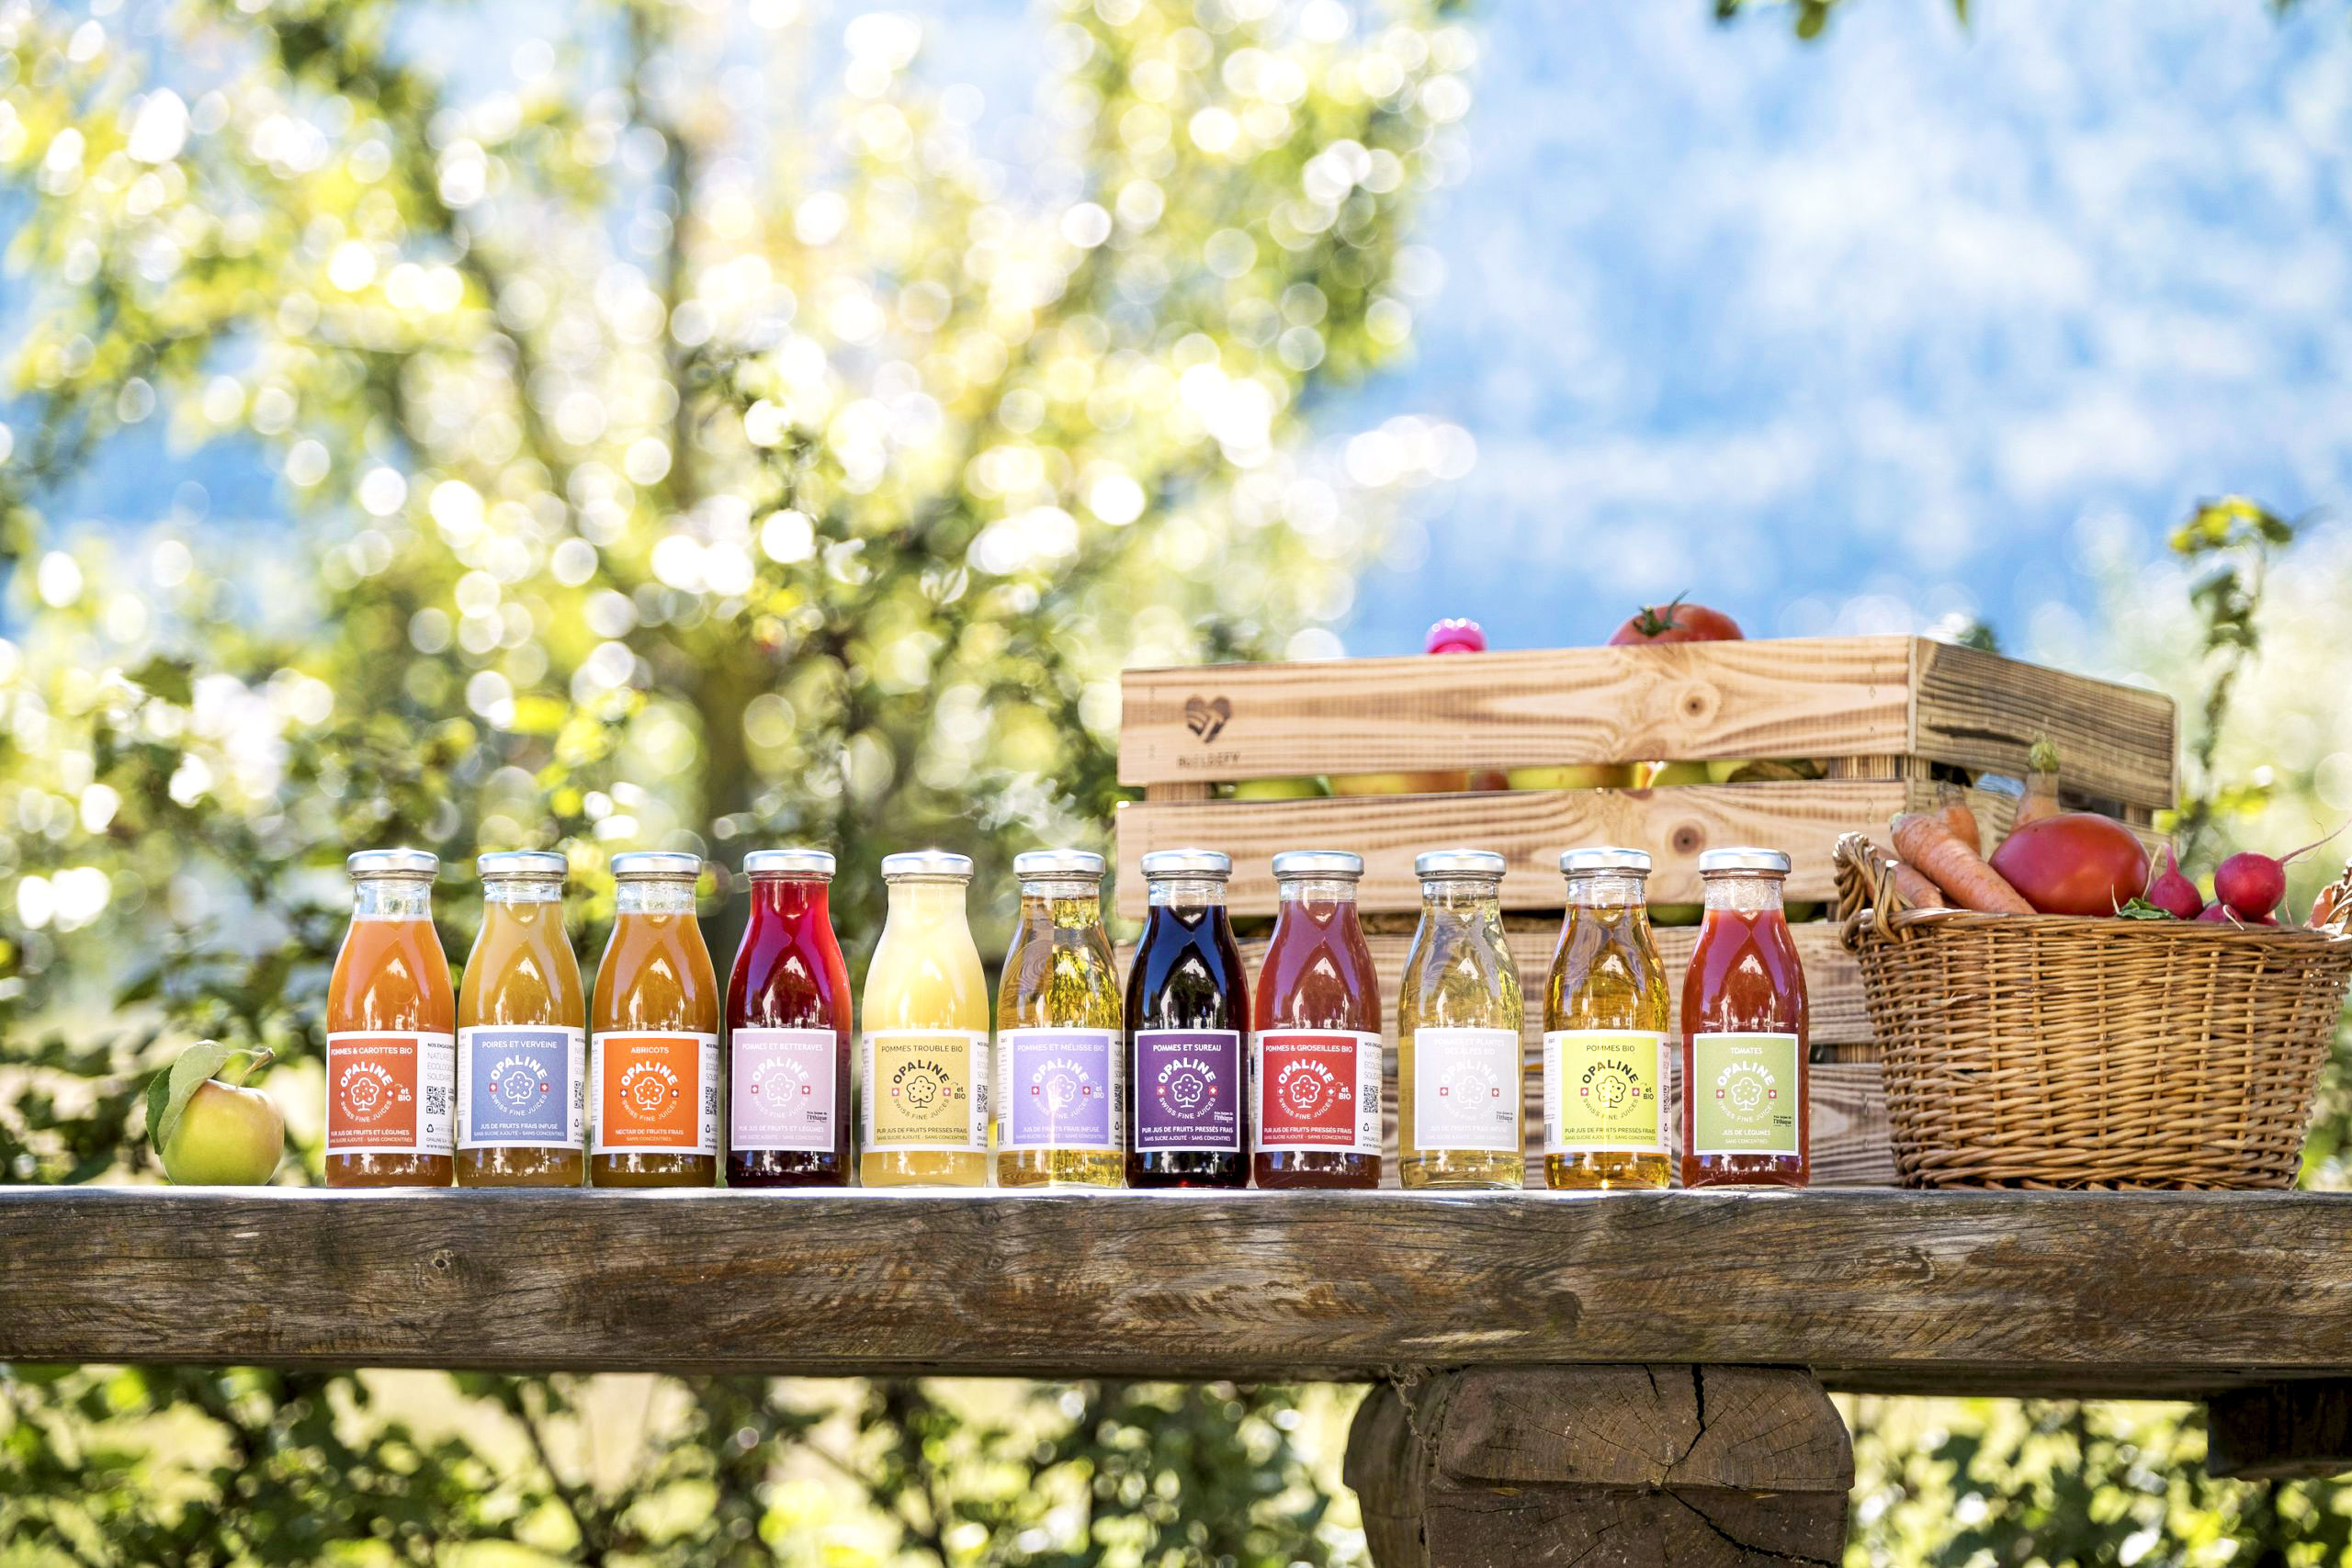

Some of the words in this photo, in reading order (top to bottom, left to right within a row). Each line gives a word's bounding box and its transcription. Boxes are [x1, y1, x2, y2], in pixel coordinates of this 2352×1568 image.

[341, 1062, 393, 1088] OPALINE
[491, 1055, 548, 1080] OPALINE
[621, 1061, 678, 1086] OPALINE
[752, 1056, 808, 1082] OPALINE
[893, 1060, 950, 1084] OPALINE
[1033, 1058, 1089, 1082] OPALINE
[1159, 1057, 1216, 1083] OPALINE
[1279, 1059, 1334, 1084] OPALINE
[1441, 1059, 1498, 1084] OPALINE
[1582, 1060, 1638, 1084] OPALINE
[1717, 1060, 1775, 1086] OPALINE
[341, 1100, 354, 1119] SWISS
[373, 1100, 391, 1120] JUICES
[492, 1094, 507, 1112] SWISS
[528, 1094, 548, 1114] JUICES
[623, 1100, 638, 1118] SWISS
[659, 1100, 676, 1120] JUICES
[893, 1099, 910, 1117] SWISS
[931, 1099, 949, 1118] JUICES
[1159, 1098, 1176, 1116] SWISS
[1197, 1098, 1216, 1117] JUICES
[1279, 1099, 1294, 1116] SWISS
[1314, 1099, 1333, 1117] JUICES
[1583, 1099, 1600, 1116] SWISS
[1621, 1099, 1638, 1118] JUICES
[1757, 1101, 1774, 1120] JUICES
